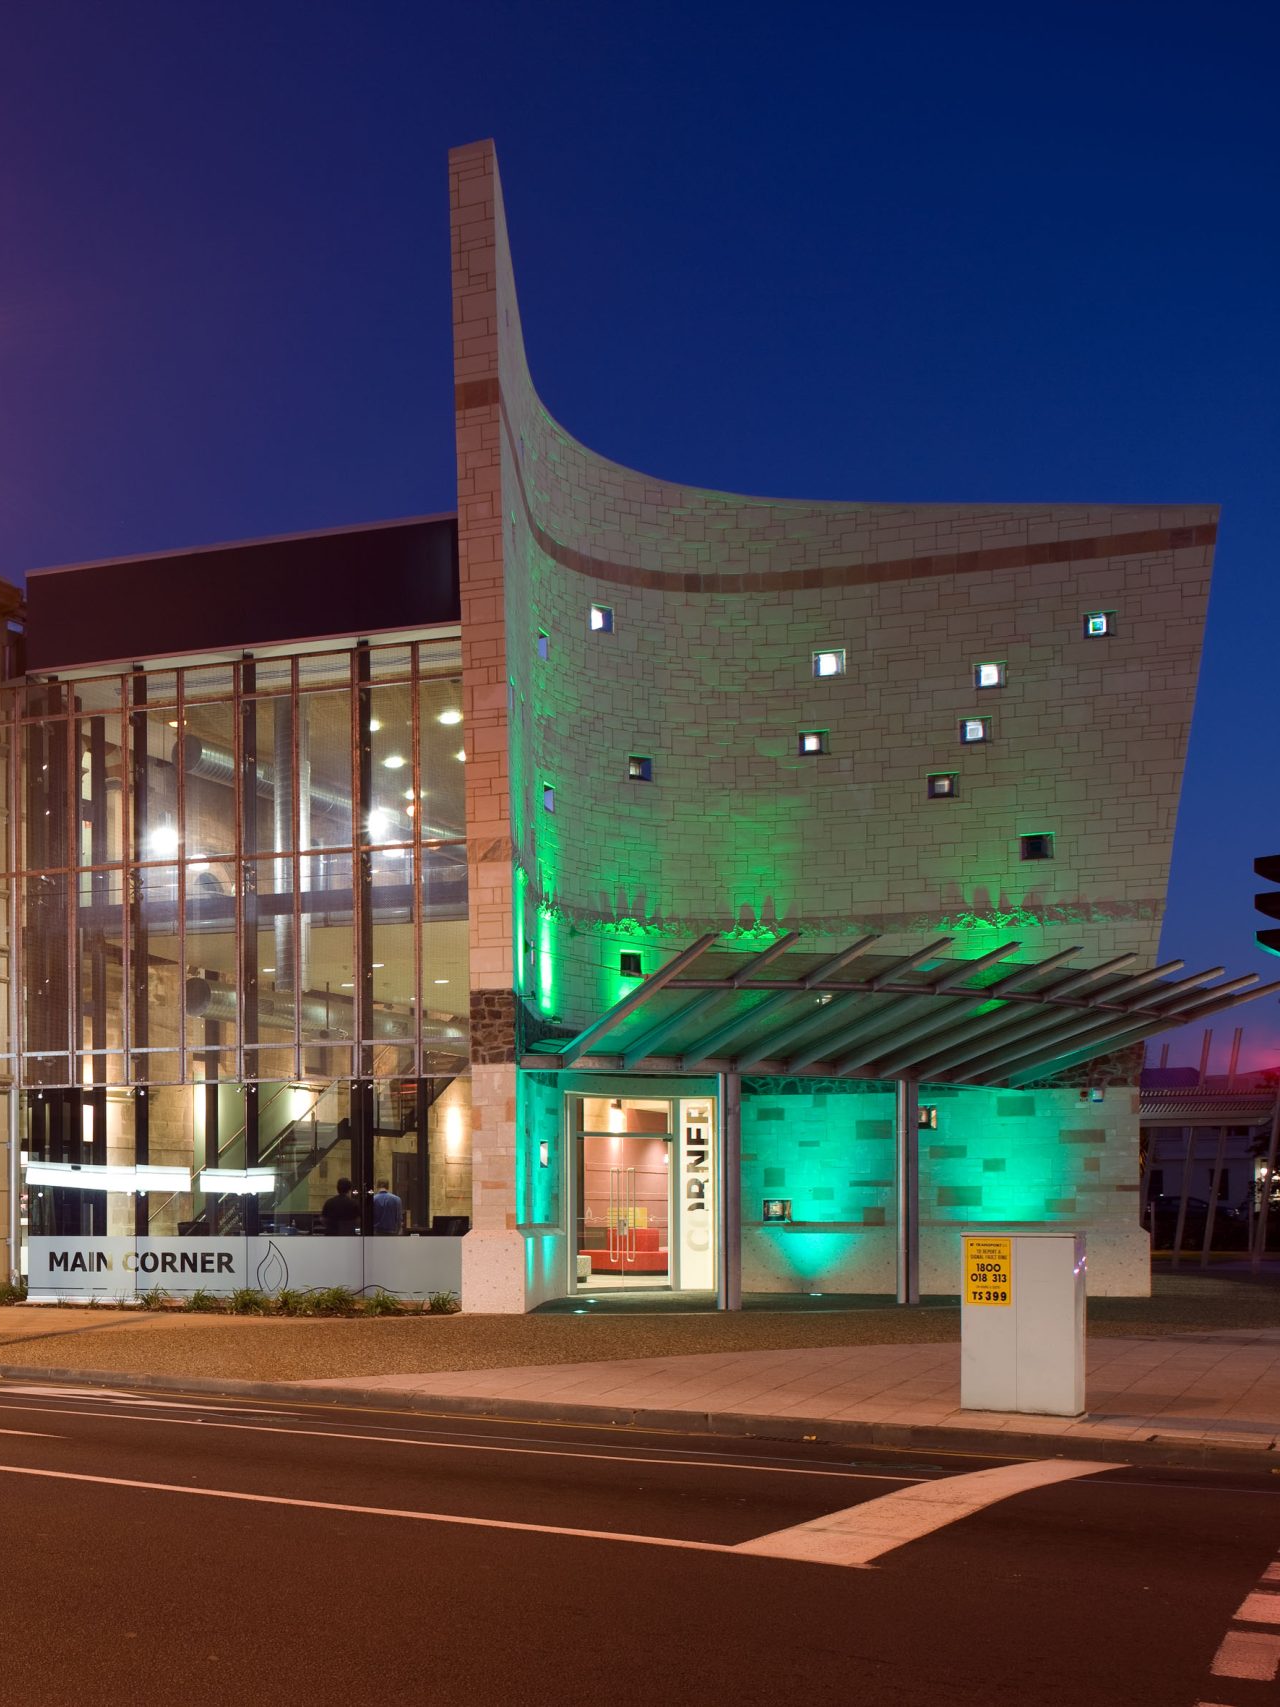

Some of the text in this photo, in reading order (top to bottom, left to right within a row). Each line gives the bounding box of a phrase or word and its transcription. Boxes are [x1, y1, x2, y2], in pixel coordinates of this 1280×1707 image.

[49, 1251, 236, 1274] MAIN CORNER
[976, 1263, 1001, 1272] 1800
[970, 1273, 1007, 1283] 018 313
[972, 1291, 1007, 1301] TS 399
